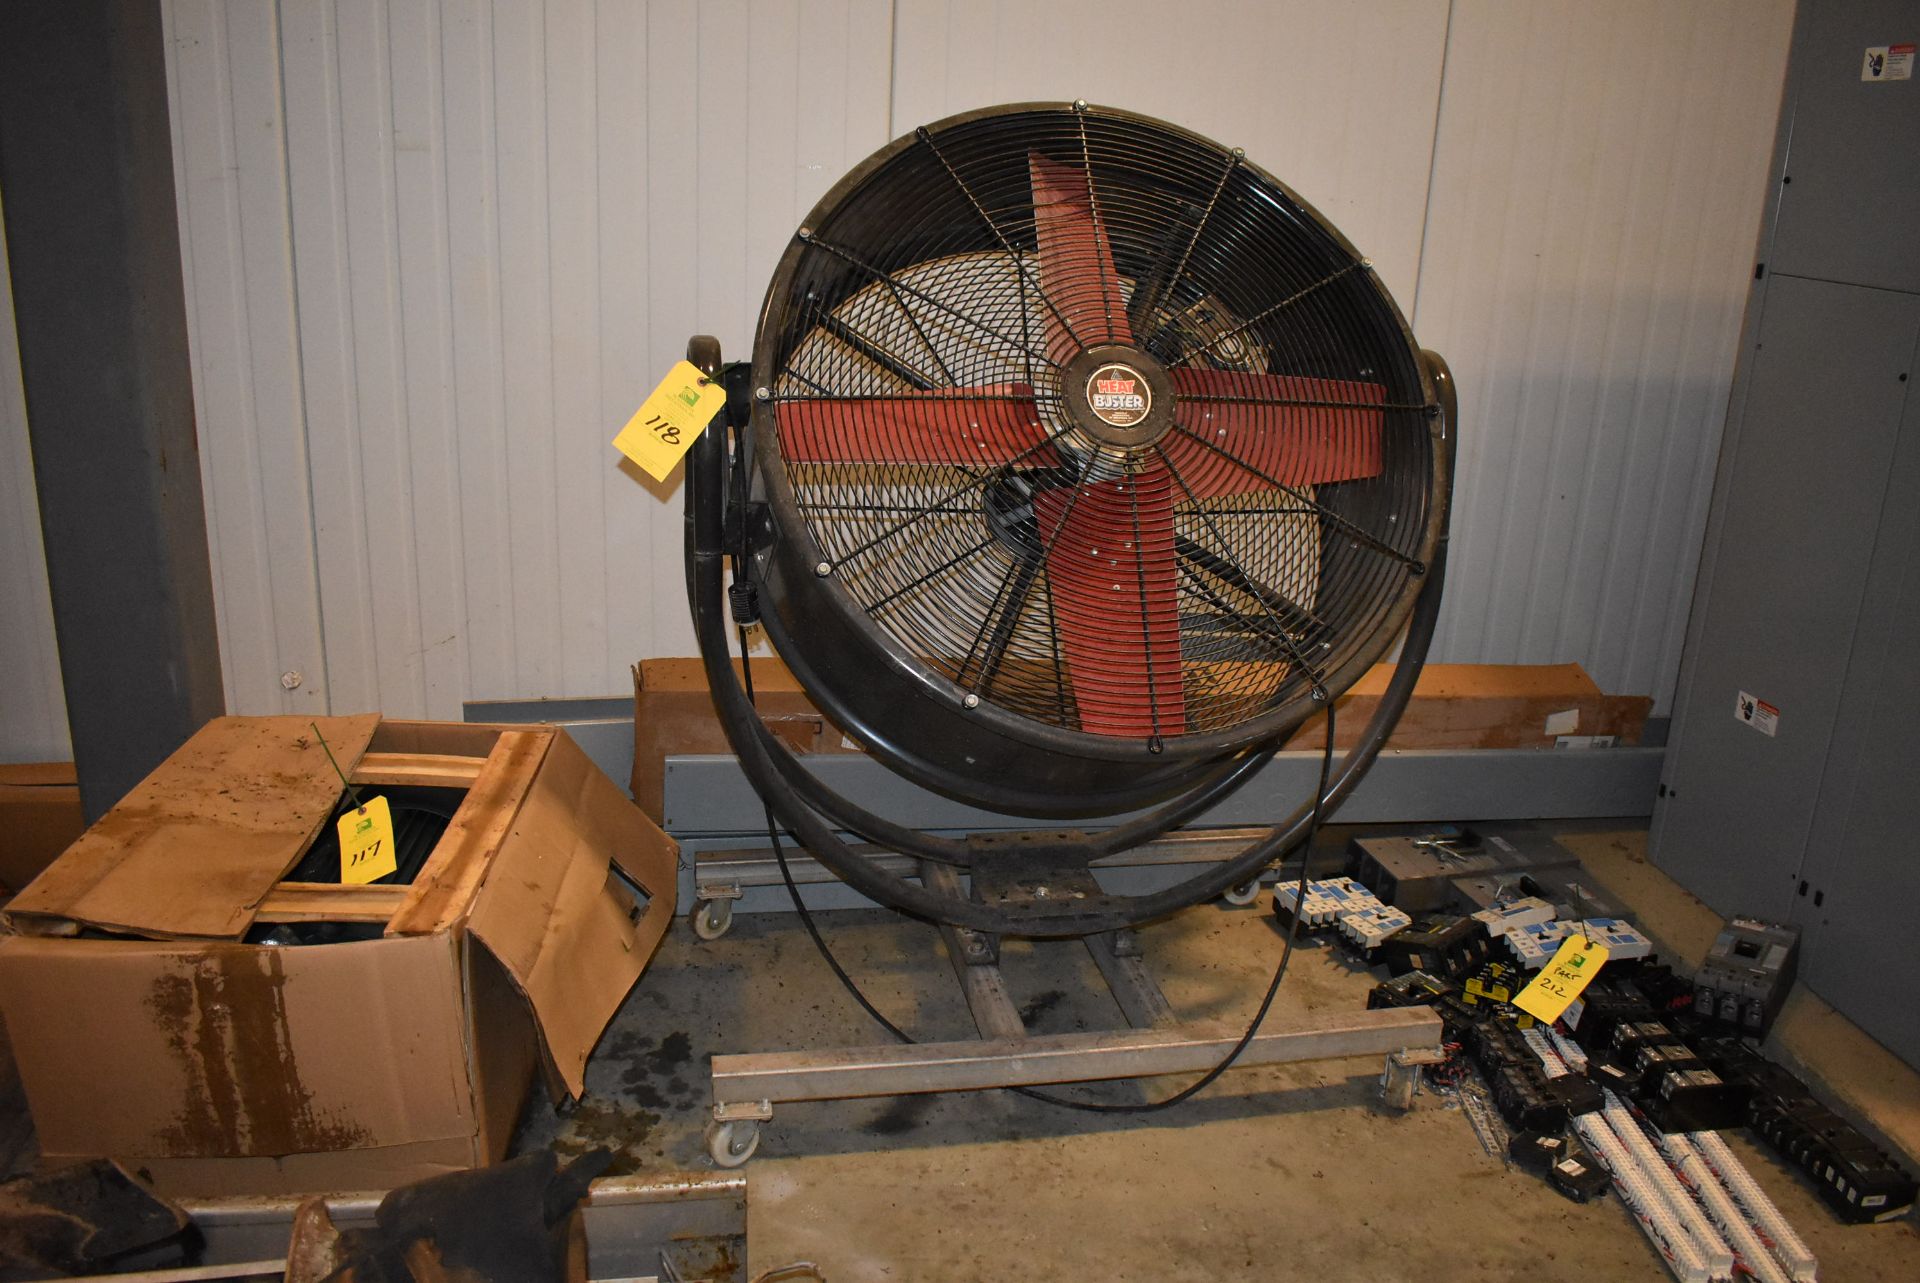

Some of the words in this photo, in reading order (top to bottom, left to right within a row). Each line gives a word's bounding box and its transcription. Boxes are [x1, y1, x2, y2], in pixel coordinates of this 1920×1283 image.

[1097, 380, 1136, 394] HEAT
[1093, 394, 1145, 410] BUSTER
[645, 415, 680, 445] 118
[351, 840, 381, 867] 117
[1540, 978, 1567, 998] 212
